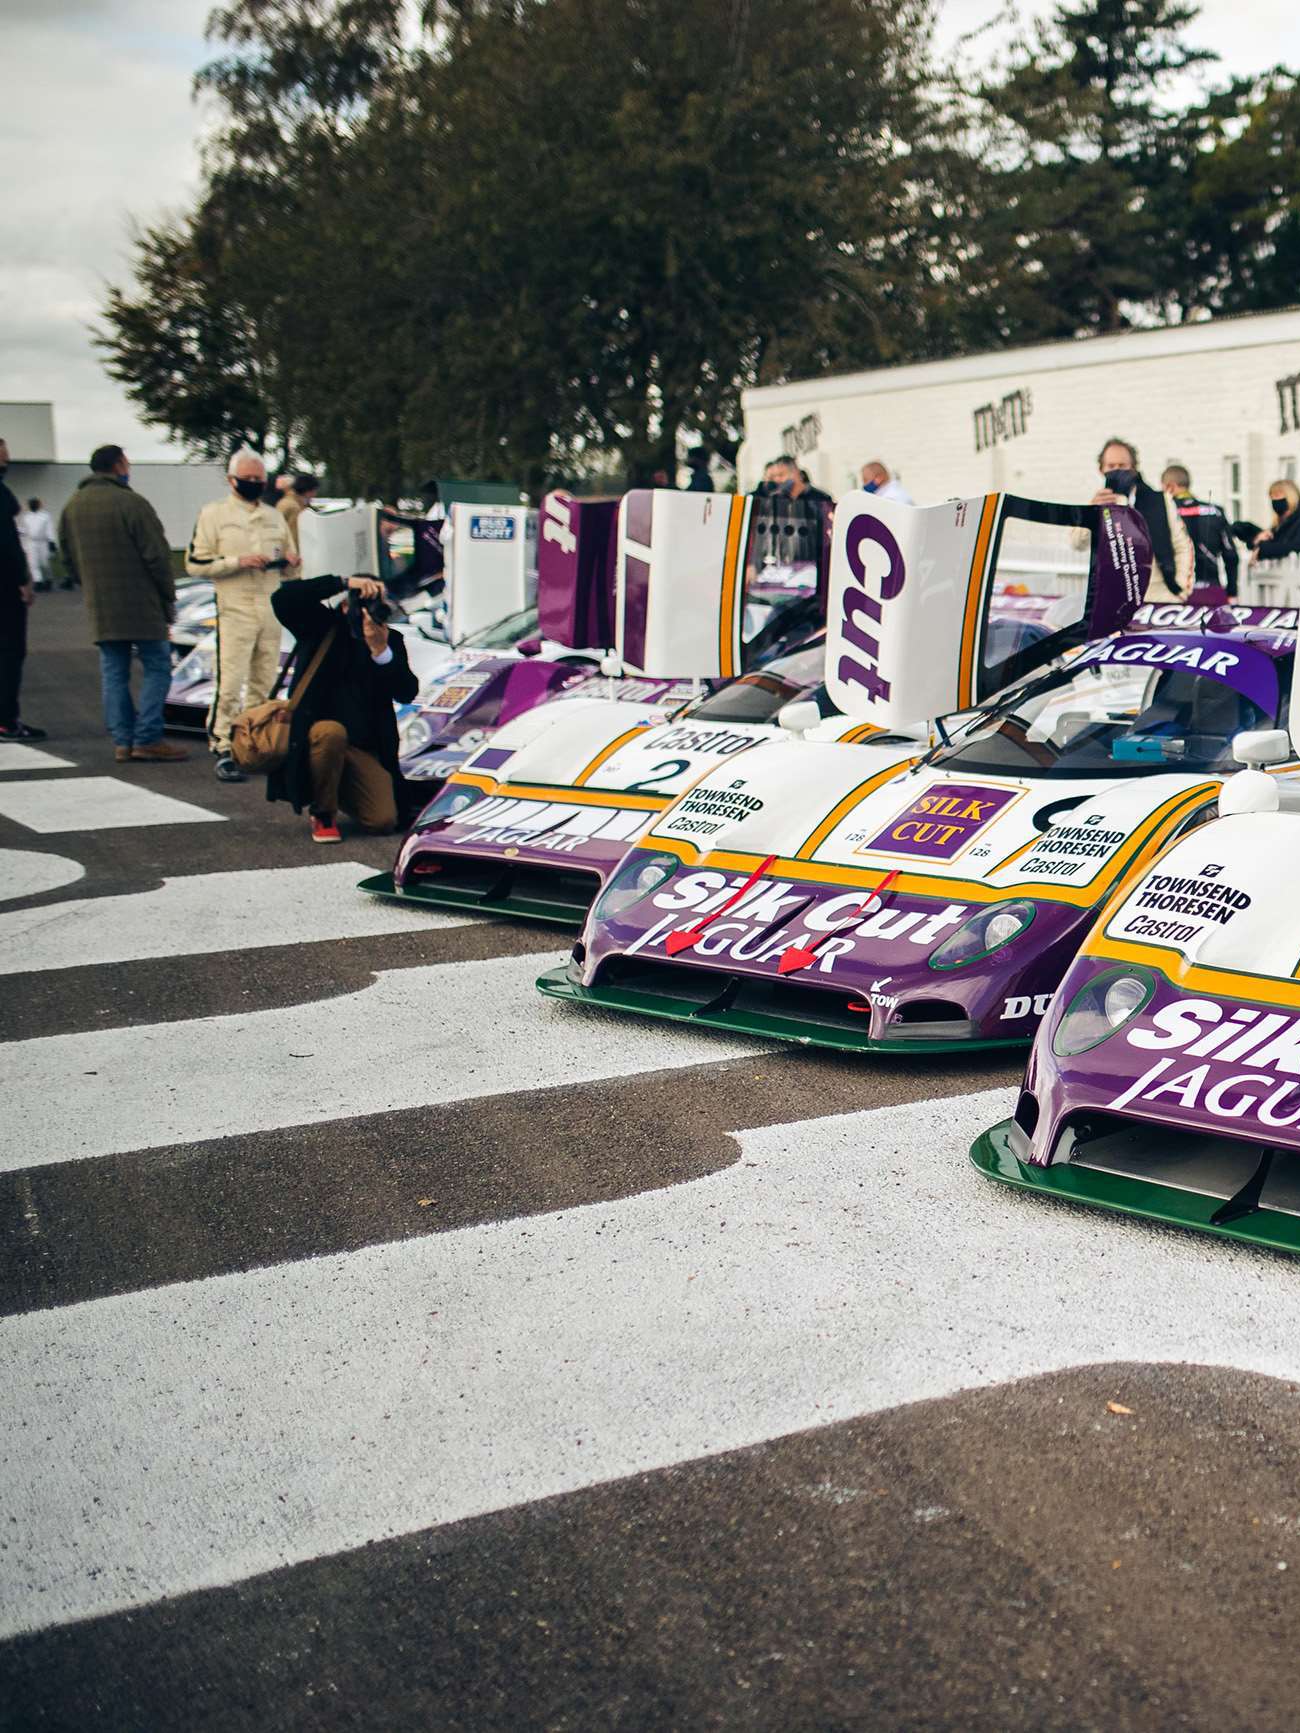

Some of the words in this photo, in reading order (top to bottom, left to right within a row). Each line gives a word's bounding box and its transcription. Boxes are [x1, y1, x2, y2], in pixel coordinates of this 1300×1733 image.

[838, 513, 906, 705] Cut
[625, 759, 691, 795] 2
[679, 801, 750, 822] THORESEN
[688, 788, 764, 812] TOWNSEND
[912, 795, 996, 822] SILK
[667, 816, 726, 835] Castrol
[845, 832, 866, 843] 128
[892, 820, 965, 848] CUT
[968, 847, 991, 857] 128
[1019, 857, 1086, 876] Castrol
[1145, 874, 1252, 911] TOWNSEND
[653, 871, 805, 924] Silk
[804, 891, 967, 945] Cut
[1135, 891, 1236, 926] THORESEN
[1124, 914, 1204, 943] Castrol
[870, 993, 900, 1009] TOW
